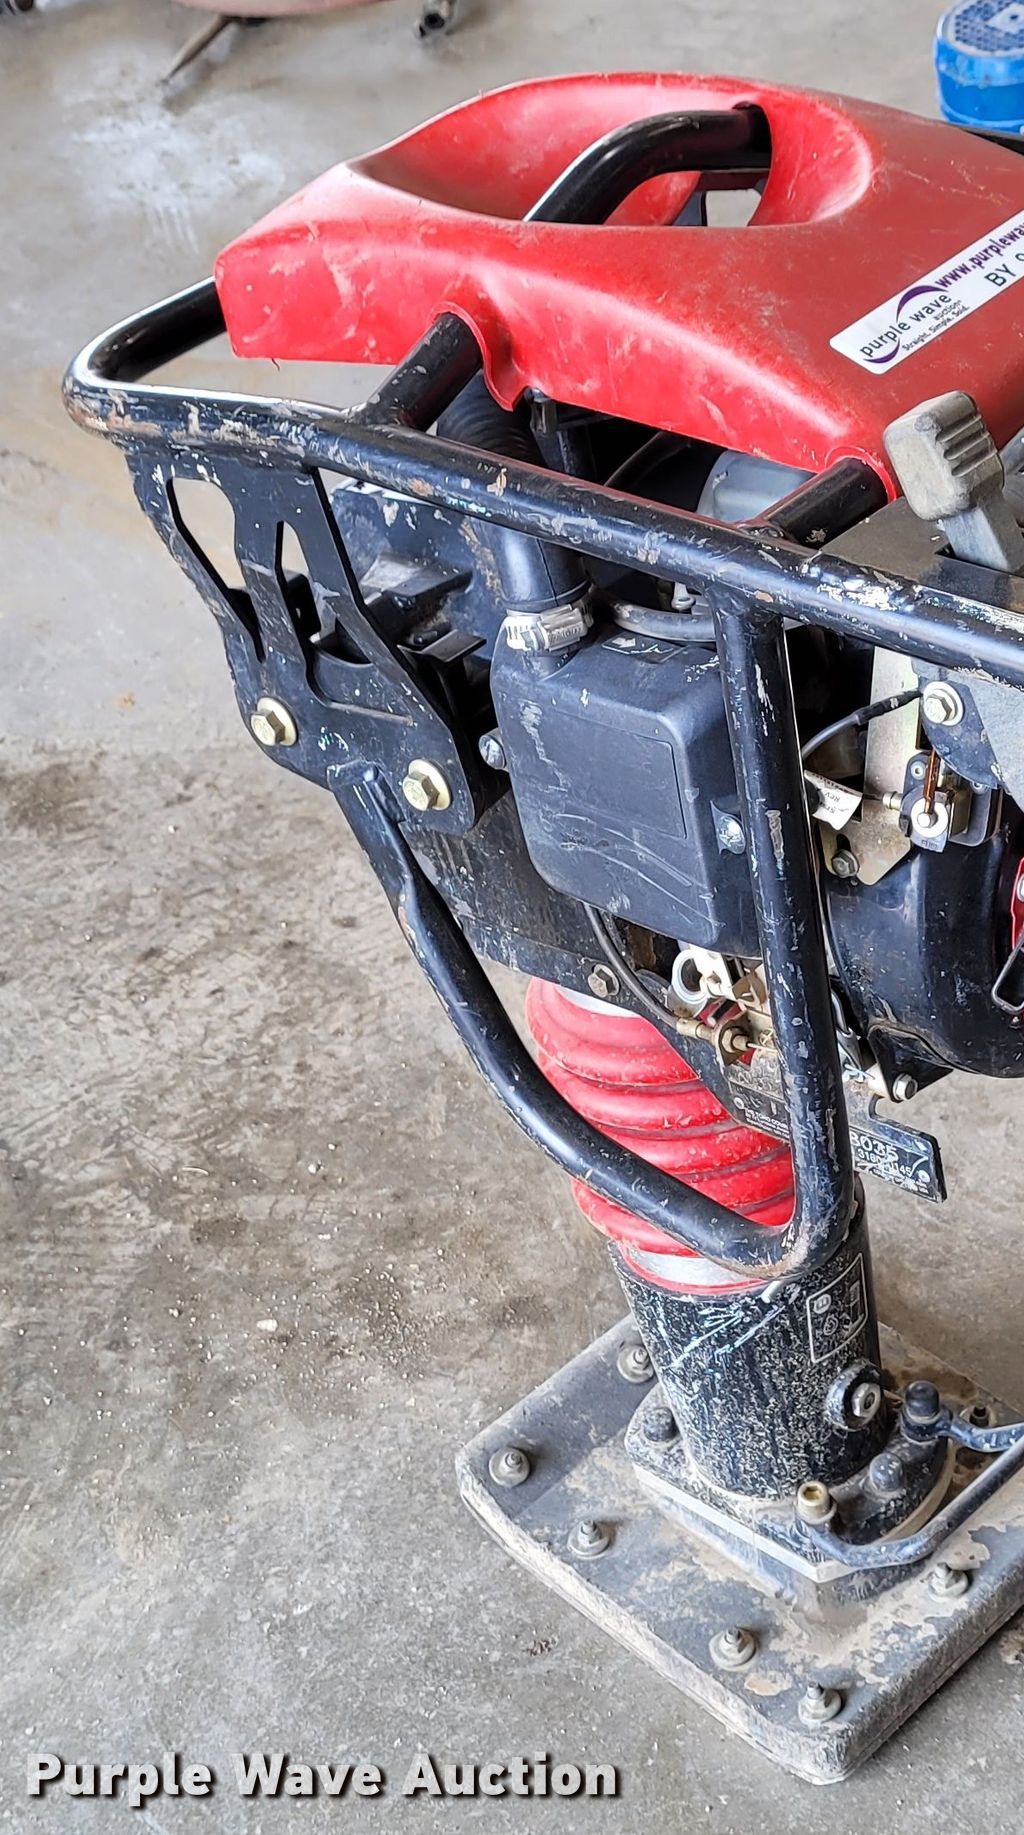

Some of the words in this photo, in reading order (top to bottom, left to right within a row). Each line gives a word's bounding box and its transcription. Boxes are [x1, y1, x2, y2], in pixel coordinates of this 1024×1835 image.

[984, 264, 1016, 287] BY
[859, 322, 911, 358] purple
[909, 294, 952, 322] wave
